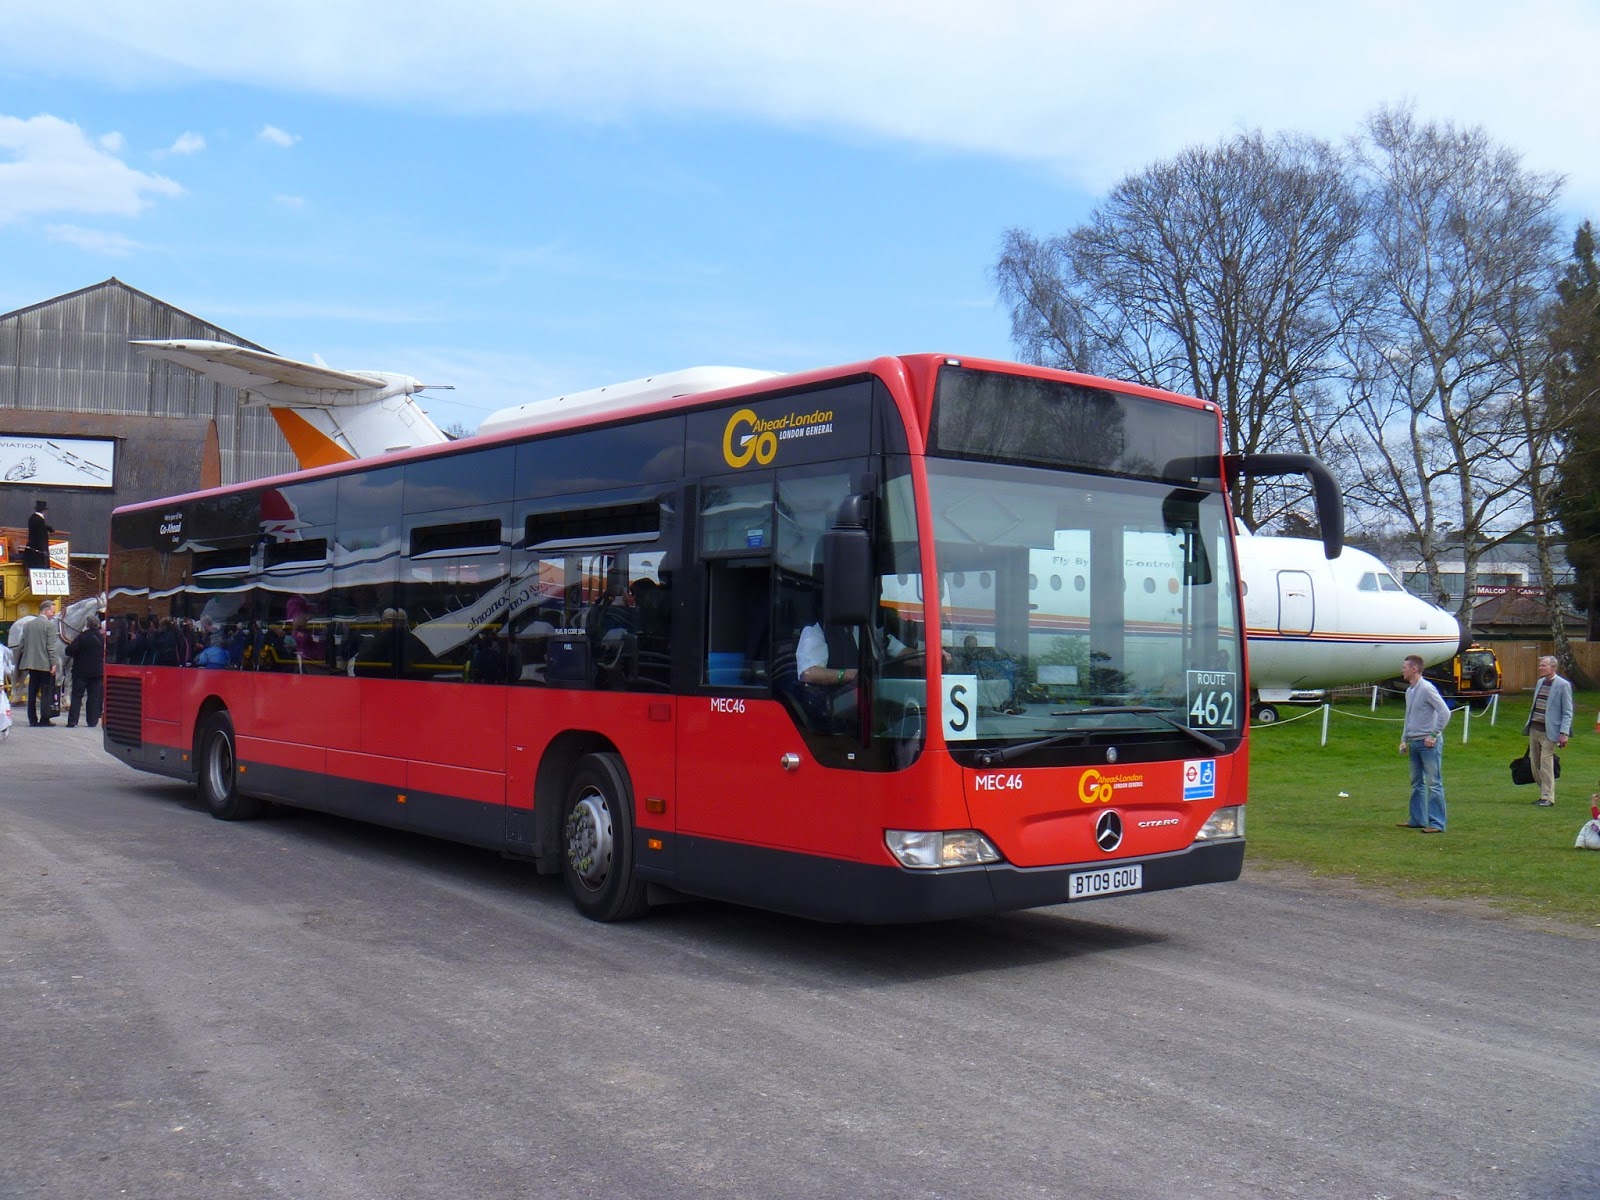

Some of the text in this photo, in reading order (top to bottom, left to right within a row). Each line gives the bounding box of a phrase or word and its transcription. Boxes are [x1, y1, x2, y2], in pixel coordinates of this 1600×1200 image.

[723, 408, 833, 468] Go Ahead-London
[779, 423, 833, 440] LONDON GENERAL
[1053, 556, 1175, 569] Fly By Control
[1197, 673, 1226, 685] ROUTE
[710, 698, 745, 713] MEC46
[949, 684, 969, 732] S
[1189, 691, 1233, 725] 462
[975, 774, 1023, 791] MEC46
[1078, 769, 1112, 803] Go
[1137, 818, 1179, 828] CITARO
[1075, 869, 1137, 894] BT09 GOU
